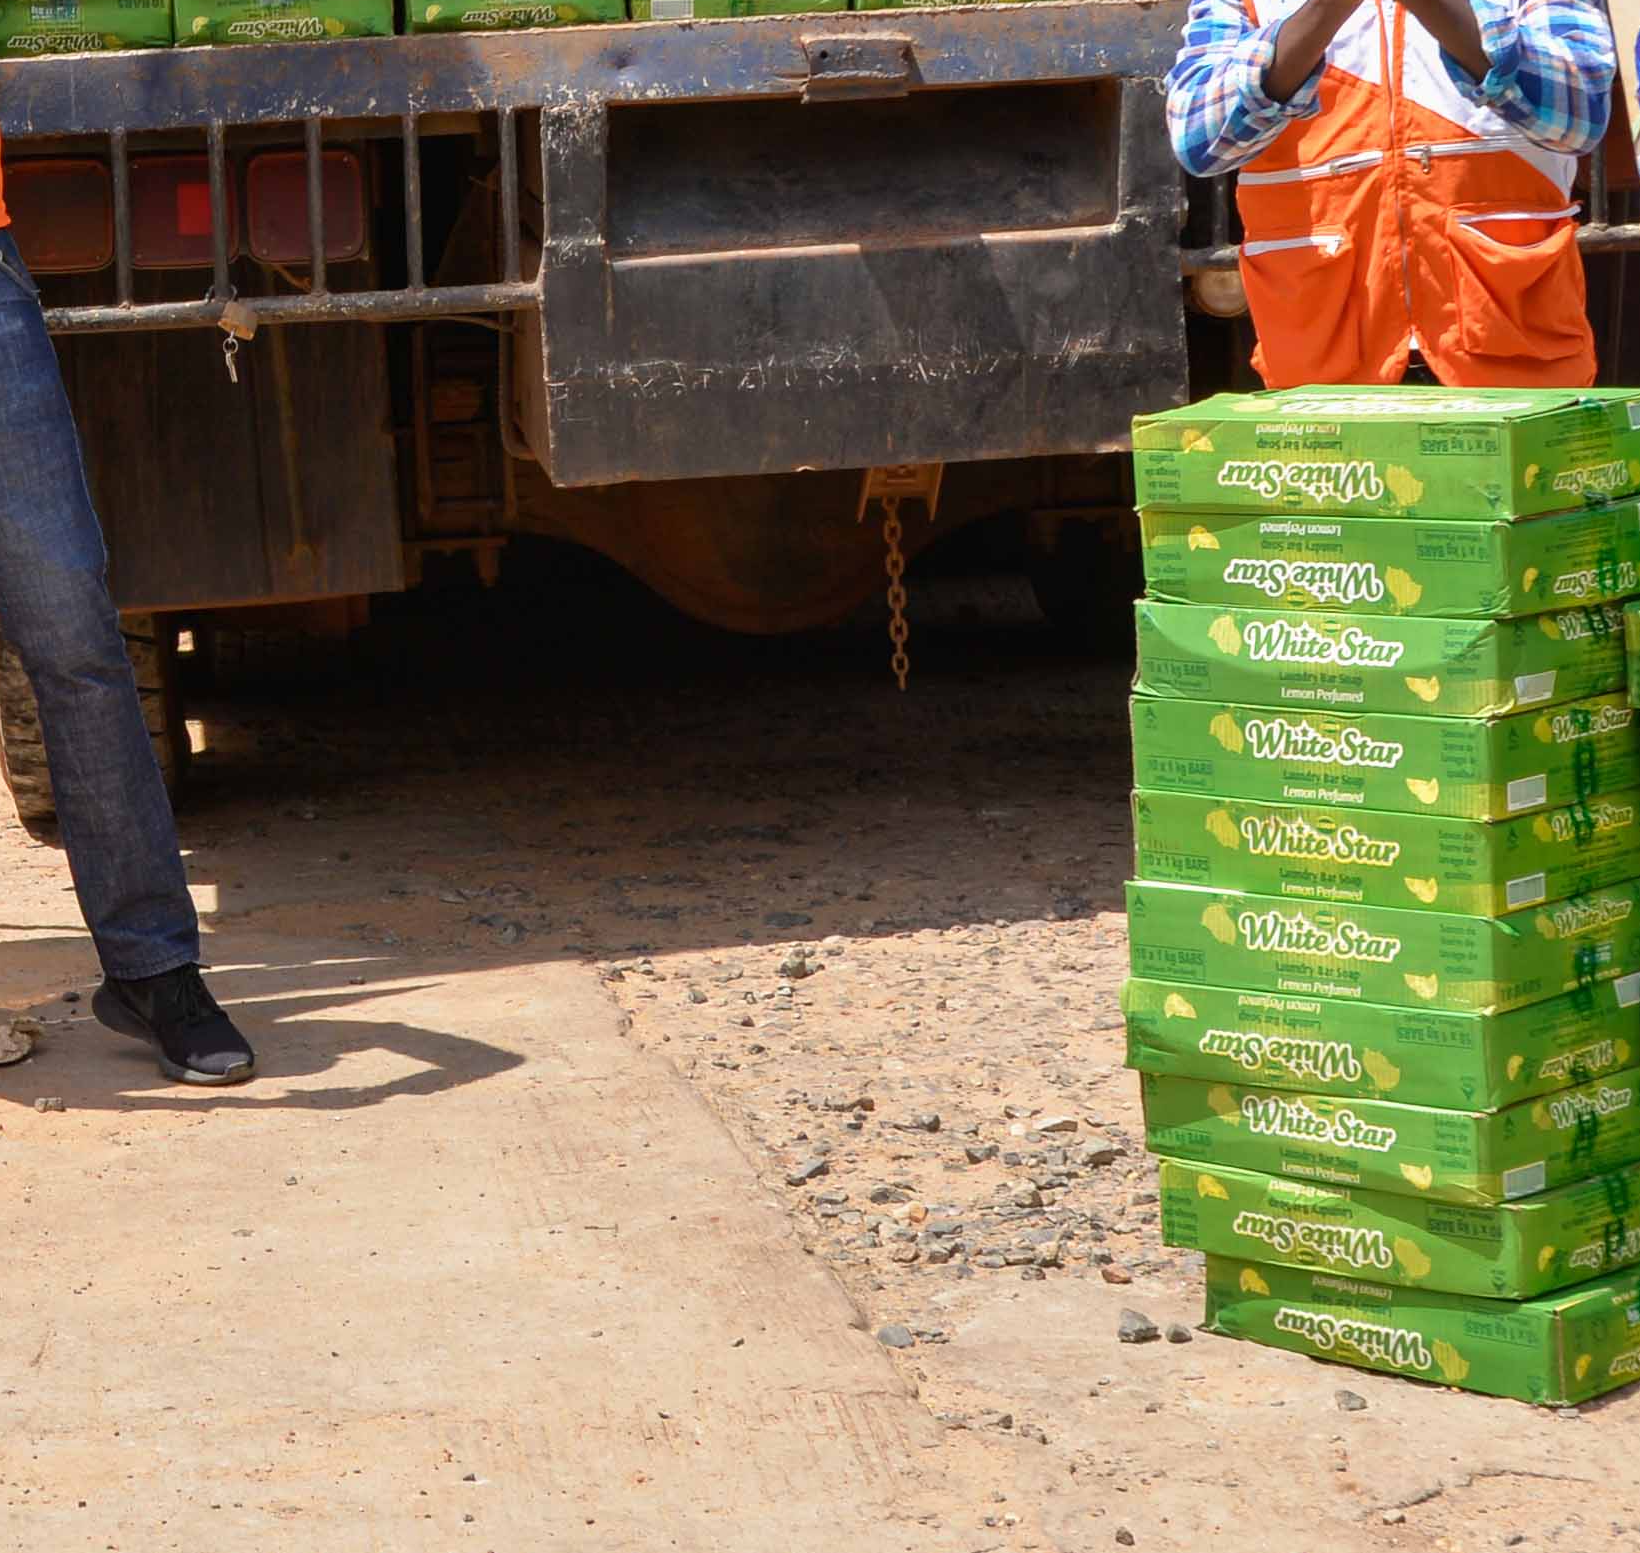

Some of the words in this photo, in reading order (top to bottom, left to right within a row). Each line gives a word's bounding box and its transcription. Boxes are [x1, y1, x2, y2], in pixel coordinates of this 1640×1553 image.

[1218, 461, 1286, 497] Star
[1288, 462, 1384, 502] White
[1225, 559, 1288, 596] Star
[1292, 560, 1384, 602] White
[1245, 620, 1335, 663] White
[1338, 628, 1403, 667] Star
[1247, 719, 1336, 760] White
[1337, 729, 1403, 768] Star
[1242, 816, 1333, 856] White
[1334, 827, 1400, 866] Star
[1239, 911, 1332, 954] White
[1333, 923, 1401, 962] Star
[1199, 1030, 1265, 1069] Star
[1269, 1040, 1361, 1081] White
[1243, 1096, 1331, 1141] White
[1332, 1110, 1396, 1152] Star
[1234, 1212, 1296, 1251] Star
[1299, 1224, 1393, 1268] White
[1275, 1308, 1336, 1349] Star
[1340, 1322, 1431, 1370] White
